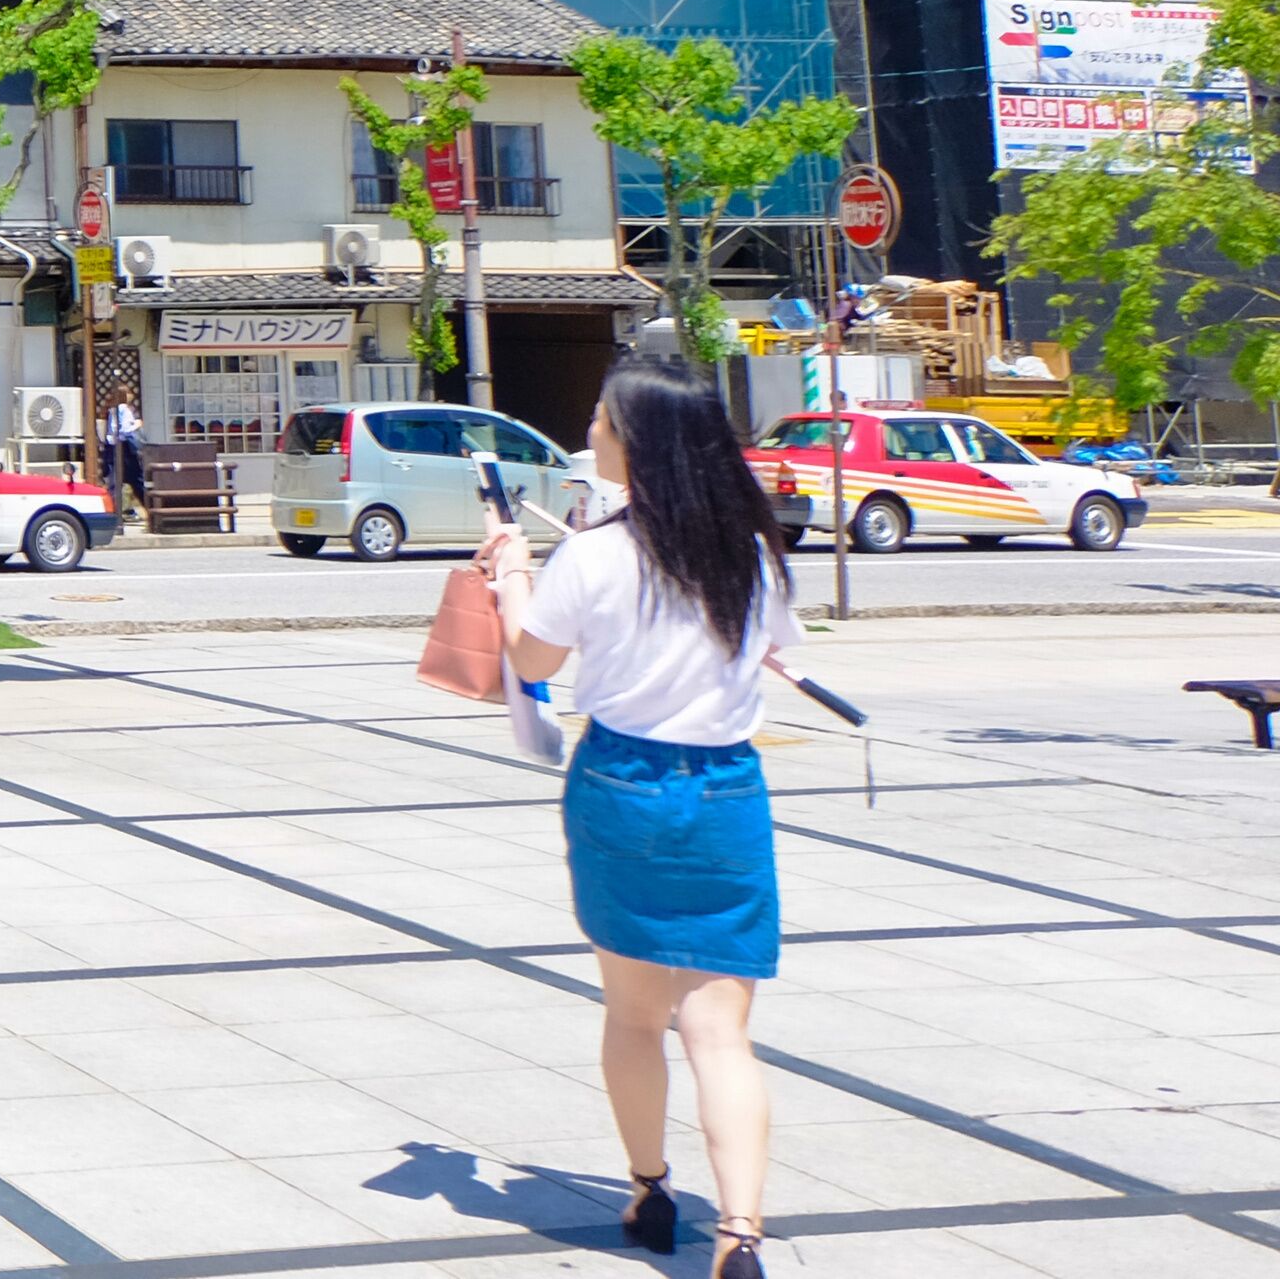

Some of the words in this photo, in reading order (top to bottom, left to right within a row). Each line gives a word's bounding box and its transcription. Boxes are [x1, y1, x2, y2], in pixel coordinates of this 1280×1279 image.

[169, 317, 346, 342] ミナトハウジング
